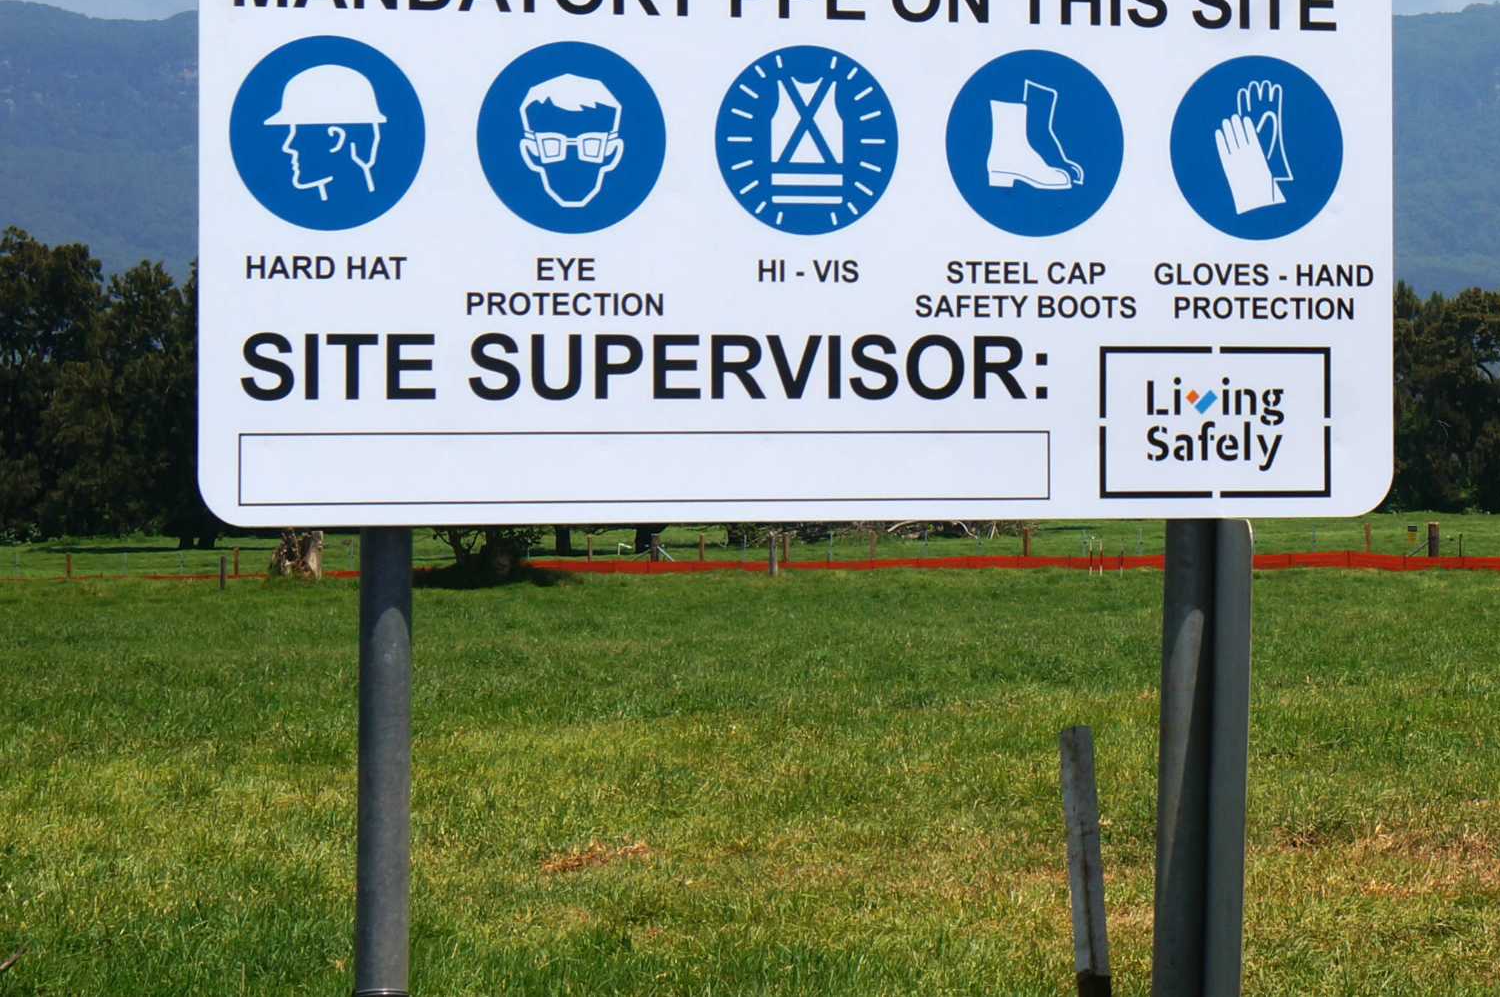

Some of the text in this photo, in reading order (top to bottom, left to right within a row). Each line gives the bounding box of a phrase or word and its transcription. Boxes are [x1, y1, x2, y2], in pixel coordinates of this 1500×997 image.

[246, 255, 408, 280] HARD HAT
[536, 257, 596, 282] EYE
[758, 259, 785, 283] HI
[812, 259, 860, 284] VIS
[946, 260, 1106, 285] STEEL CAP
[1154, 262, 1270, 287] GLOVES
[1296, 263, 1374, 287] HAND
[466, 291, 664, 317] PROTECTION
[915, 294, 1137, 319] SAFETY BOOTS
[1174, 296, 1355, 321] PROTECTION
[240, 332, 1048, 402] SITE SUPERVISOR:
[1146, 420, 1283, 472] Safely
